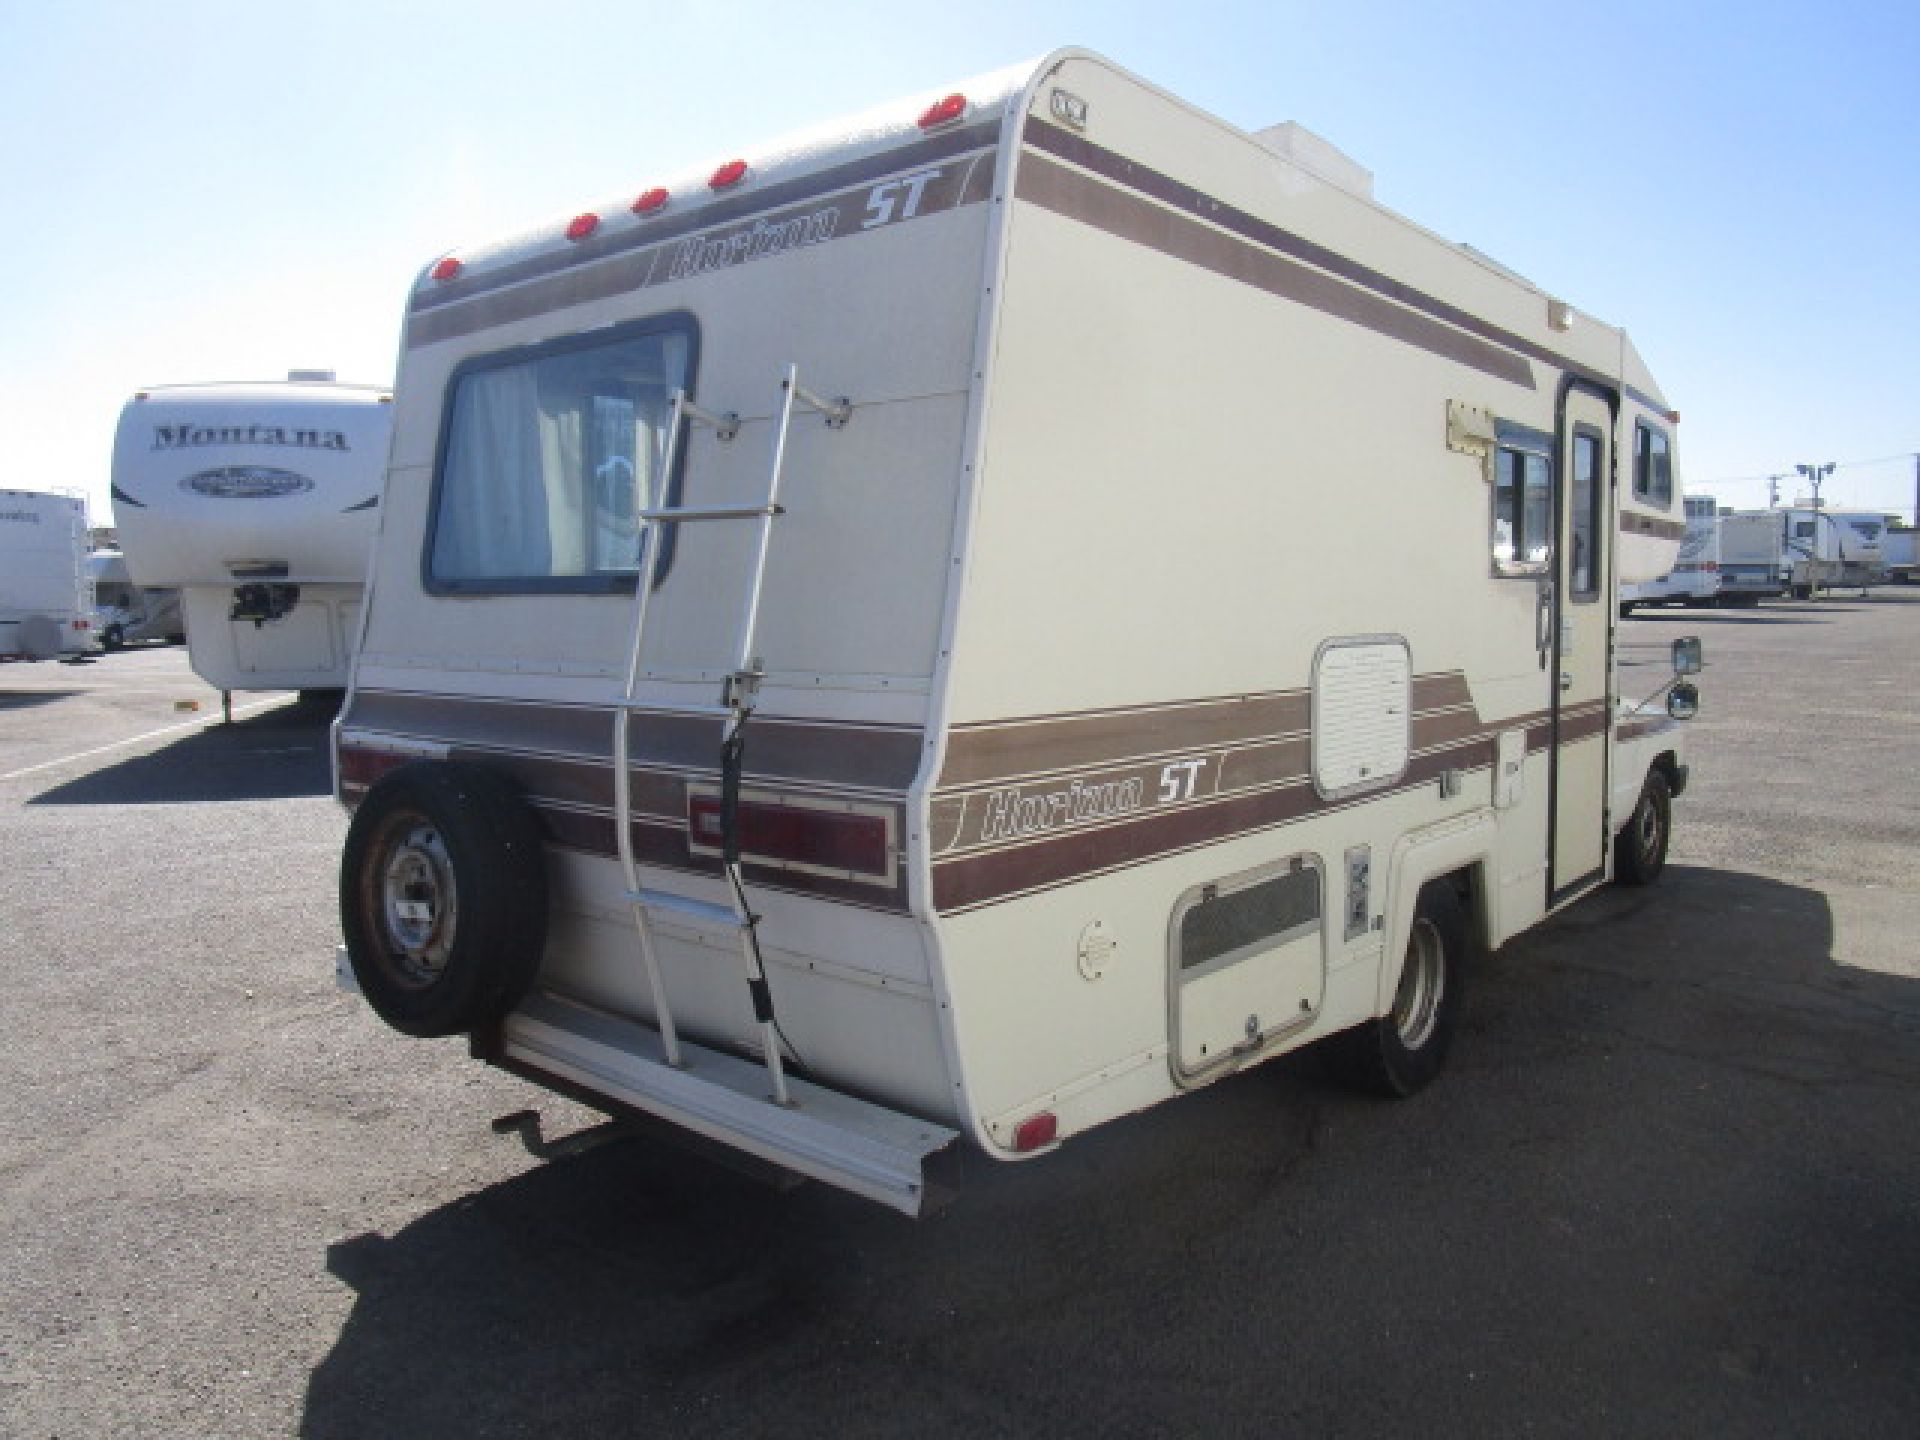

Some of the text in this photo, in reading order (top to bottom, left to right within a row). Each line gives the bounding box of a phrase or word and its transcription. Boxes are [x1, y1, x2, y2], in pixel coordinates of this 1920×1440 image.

[863, 169, 942, 228] ST
[150, 423, 351, 452] Montana
[1158, 759, 1207, 801] ST
